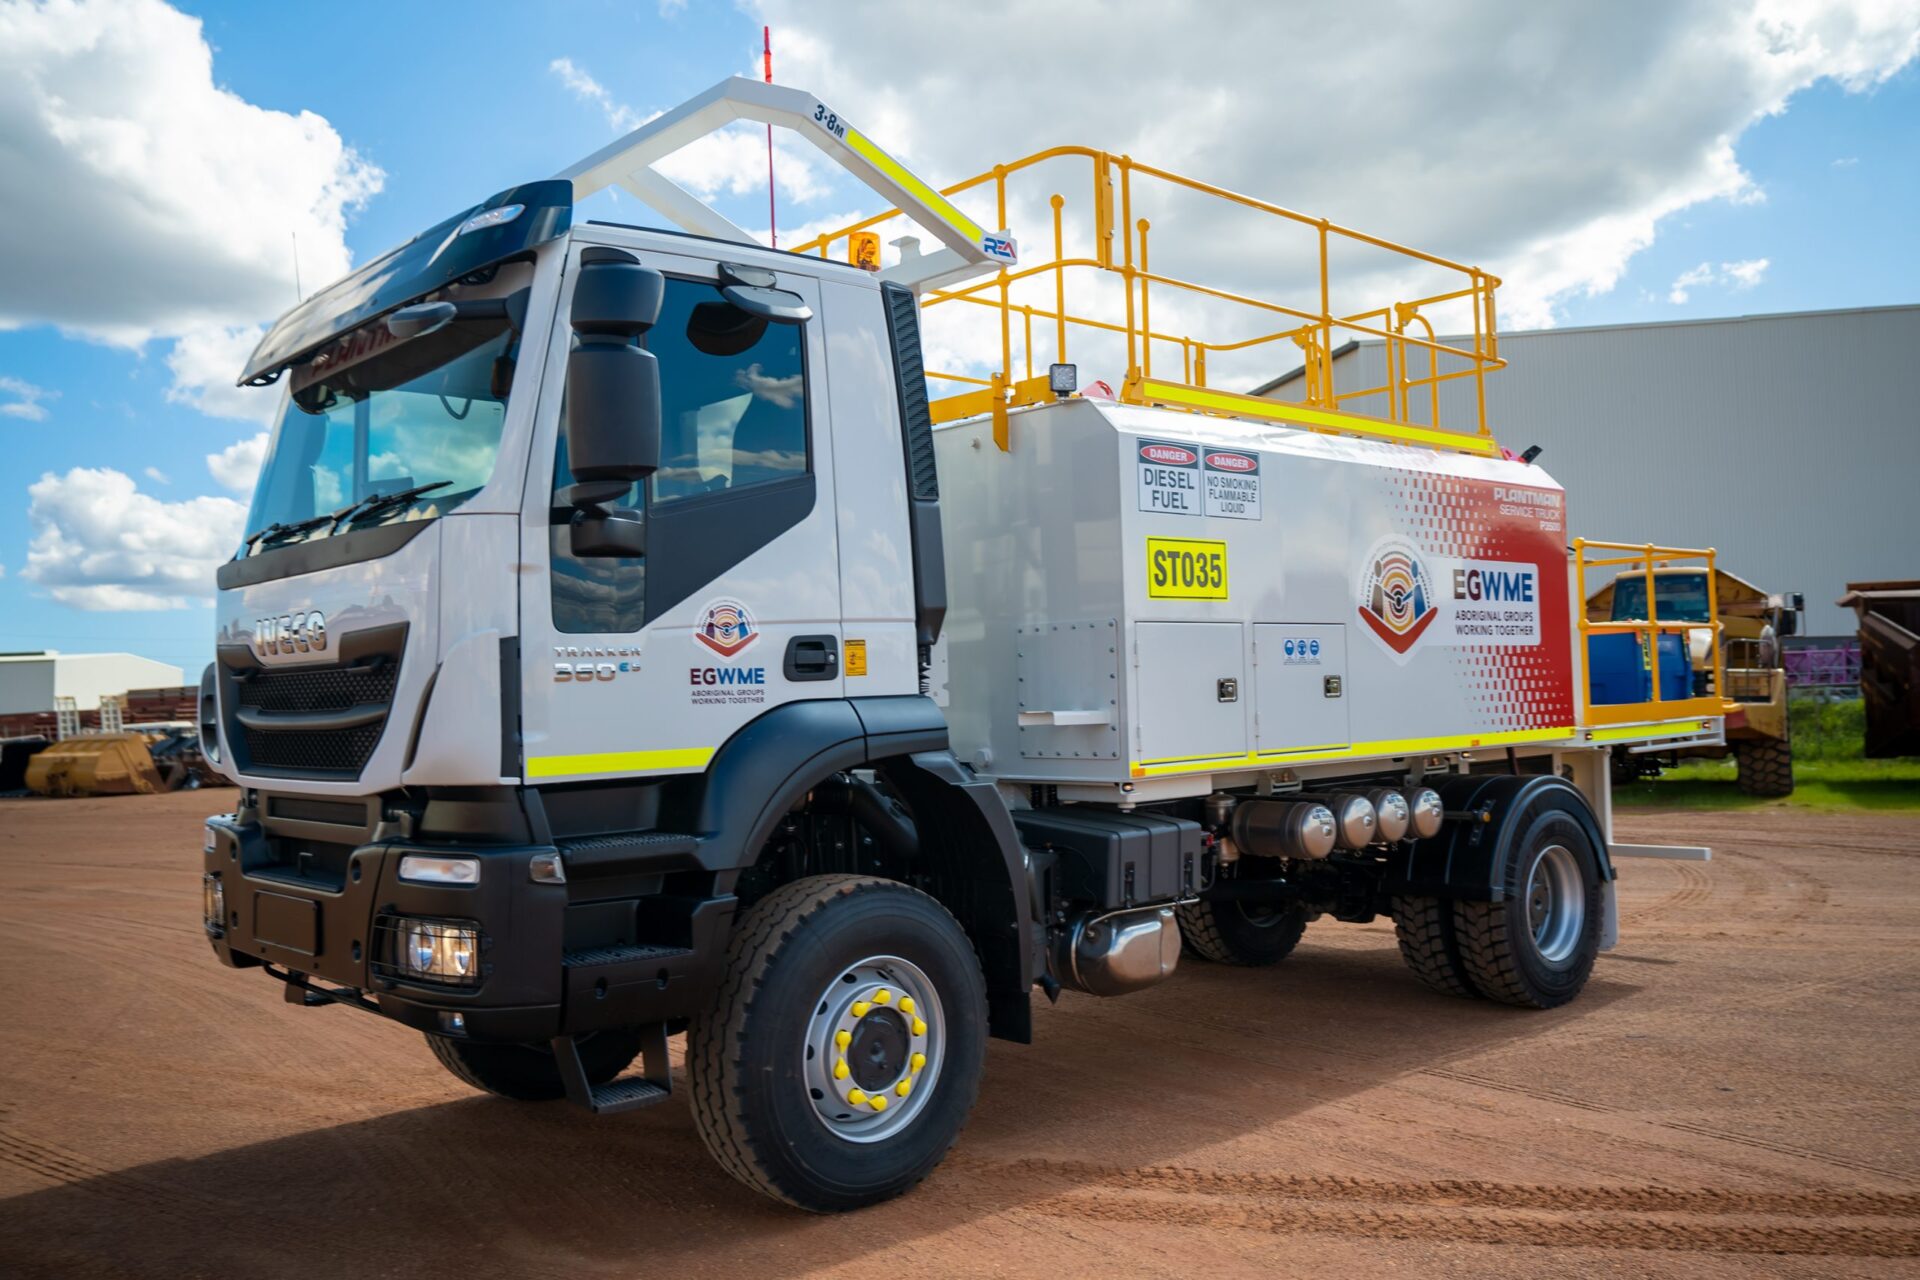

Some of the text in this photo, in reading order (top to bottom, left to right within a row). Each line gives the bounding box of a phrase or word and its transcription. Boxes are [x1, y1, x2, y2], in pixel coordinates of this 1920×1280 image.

[984, 237, 1017, 258] REA
[1149, 448, 1188, 462] DANGER
[1214, 456, 1249, 469] DANGER
[1144, 468, 1195, 490] DIESEL
[1207, 476, 1257, 491] NO SMOKING
[1152, 490, 1189, 510] FUEL
[1208, 488, 1256, 503] FLAMMABLE
[1494, 487, 1561, 507] PLANTMAN
[1220, 502, 1246, 514] LIQUID
[1499, 504, 1561, 520] SERVICE TRUCK
[1153, 549, 1223, 589] ST035
[1453, 569, 1534, 602] EGWME
[1455, 610, 1534, 622] ABORIGINAL GROUPS
[256, 610, 327, 657] IVECO
[1455, 624, 1534, 636] WORKING TOGETHER
[553, 646, 642, 658] TRAKKER
[553, 662, 617, 683] 360
[690, 667, 765, 685] EGWME
[691, 688, 765, 697] ABORIGINAL GROUPS
[691, 696, 765, 705] WORKING TOGETHER
